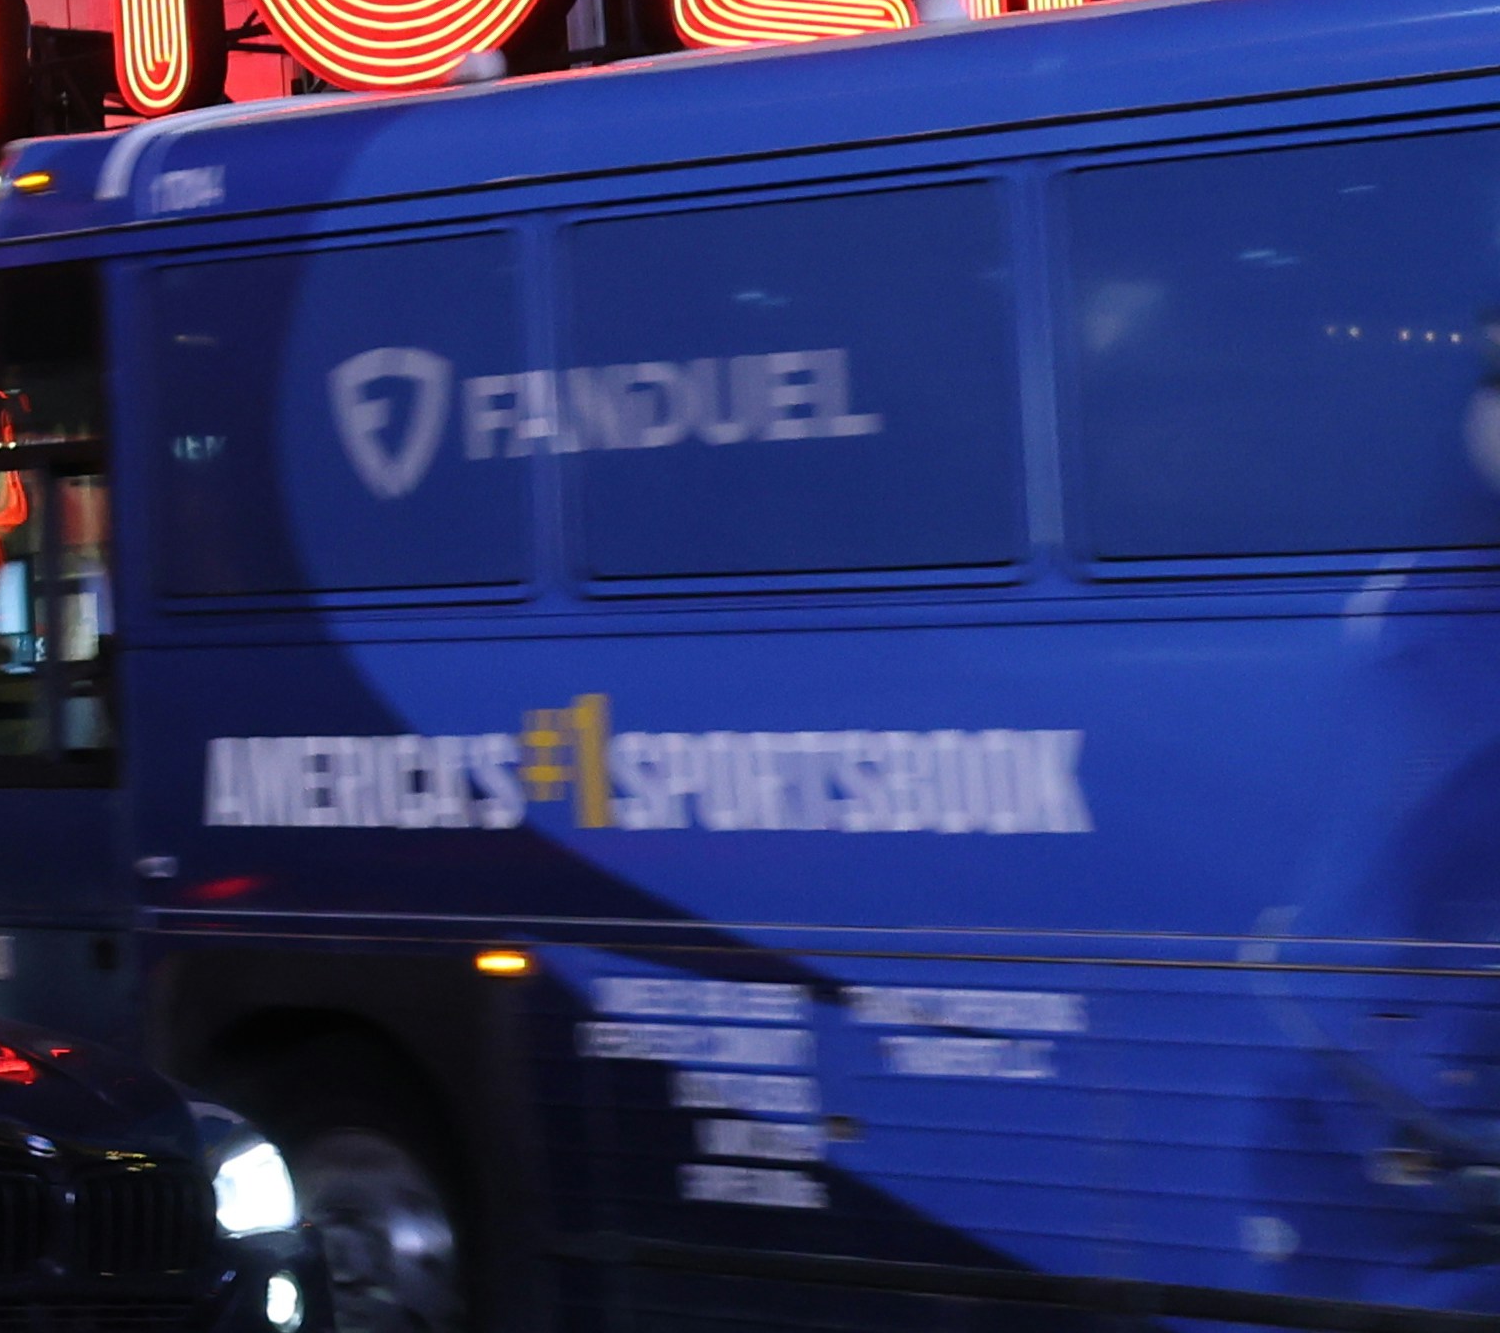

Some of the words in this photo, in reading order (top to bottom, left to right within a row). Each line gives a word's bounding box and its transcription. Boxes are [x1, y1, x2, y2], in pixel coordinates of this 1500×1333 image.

[463, 348, 884, 461] FANDUEL
[203, 735, 526, 829] AMERICA'S
[611, 729, 1093, 834] SPORTSBOOK
